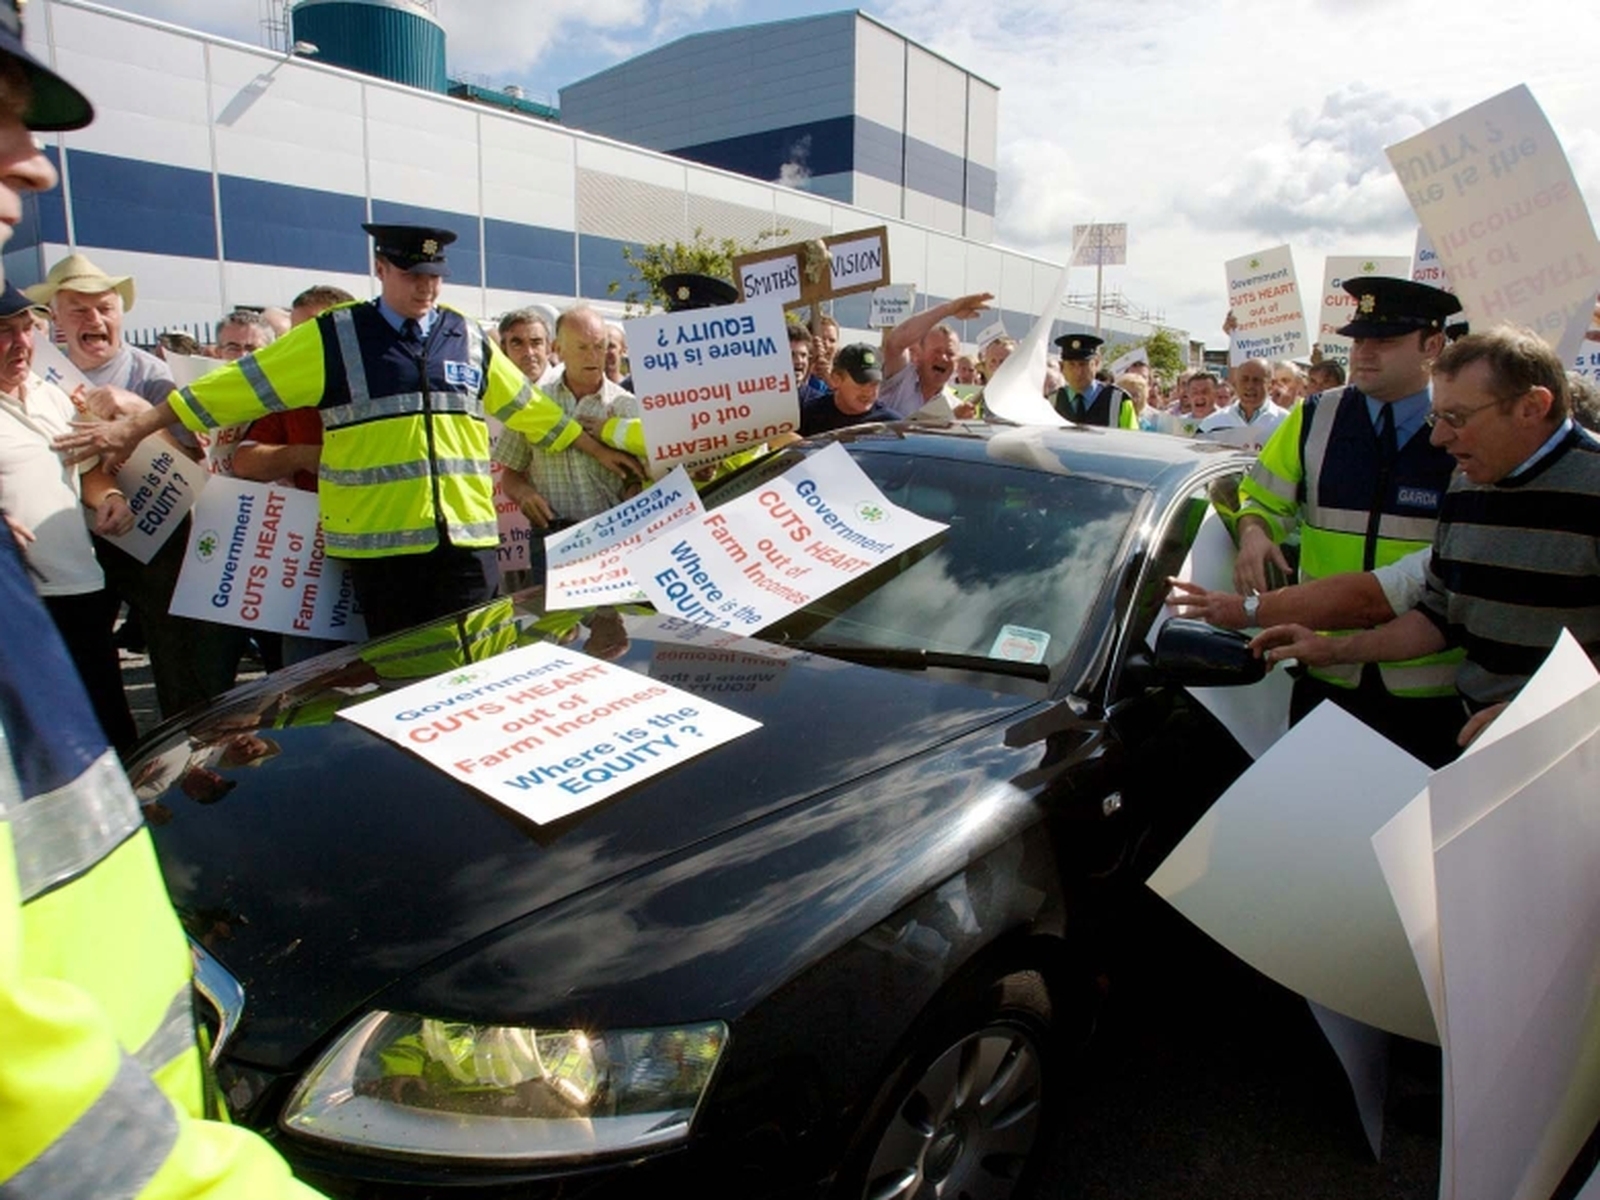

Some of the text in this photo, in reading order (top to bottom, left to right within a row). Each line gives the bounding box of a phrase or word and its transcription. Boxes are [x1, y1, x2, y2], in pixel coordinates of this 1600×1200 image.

[744, 246, 882, 299] SMITH'S VISION
[1231, 268, 1288, 290] Government
[1258, 282, 1296, 300] HEART
[657, 315, 756, 347] EQUITY ?
[1237, 319, 1258, 331] arm
[1237, 335, 1271, 350] Where
[643, 337, 778, 371] Where is the
[1246, 345, 1286, 359] EQUITY
[642, 373, 791, 411] Farm Incomes
[691, 405, 751, 431] out of
[735, 422, 794, 445] CUTS
[654, 434, 729, 461] HEART
[130, 485, 153, 516] ere
[151, 452, 174, 474] the
[137, 472, 189, 536] EQUITY ?
[592, 488, 664, 530] EQUITY
[620, 490, 683, 529] Where
[647, 501, 697, 534] Farm
[795, 479, 895, 554] Government
[212, 494, 255, 608] Government
[510, 528, 531, 542] the
[552, 534, 643, 570] Incomes
[758, 490, 872, 574] CUTS HEART
[240, 491, 286, 621] CUTS HEART
[281, 532, 304, 589] out of
[703, 513, 810, 605] Farm Incomes
[758, 538, 813, 580] out of
[330, 569, 353, 628] Where
[654, 567, 719, 627] EQUITY
[670, 540, 723, 602] Where
[717, 598, 738, 613] is
[733, 604, 763, 625] the
[293, 584, 319, 631] Farm
[395, 658, 574, 722] Government
[408, 664, 613, 744] CUTS HEART
[454, 686, 669, 775] Farm Incomes
[502, 692, 590, 734] out of
[503, 705, 700, 791] Where is the
[557, 724, 705, 796] EQUITY ?
